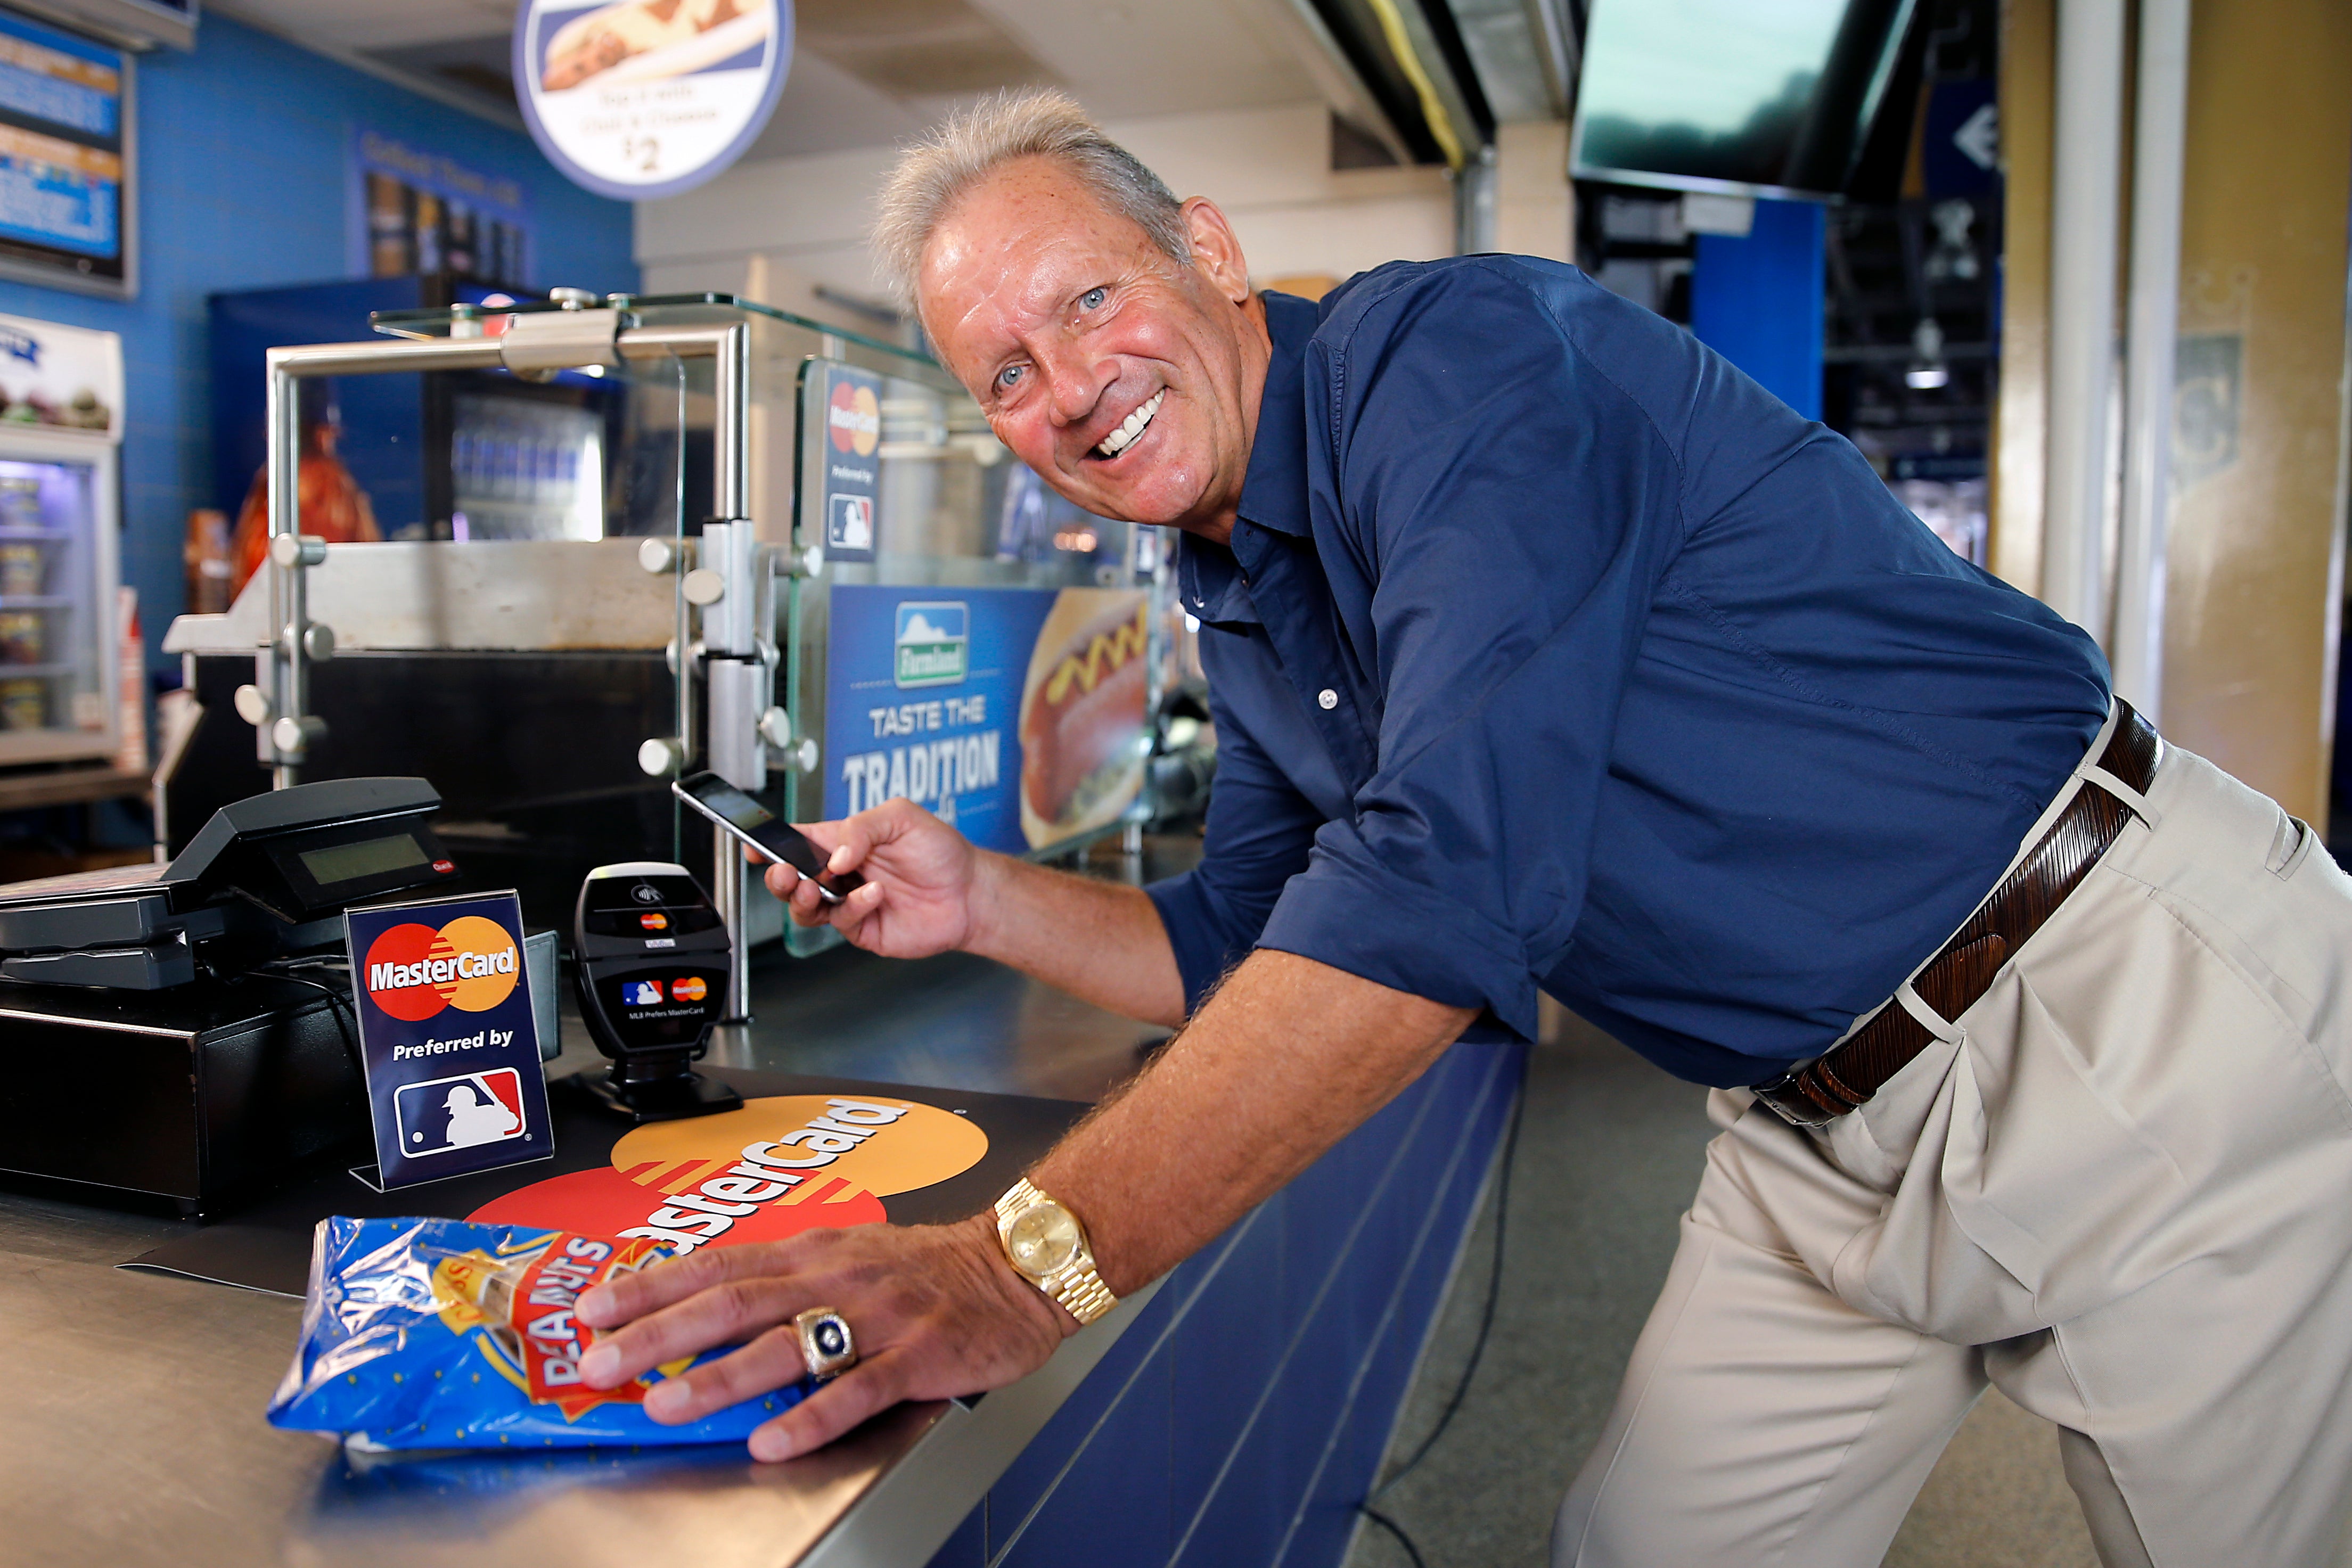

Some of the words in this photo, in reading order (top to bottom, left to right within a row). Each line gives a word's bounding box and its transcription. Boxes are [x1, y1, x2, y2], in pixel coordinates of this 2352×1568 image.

[868, 700, 942, 738] TASTE
[945, 694, 987, 726] THE
[841, 729, 1001, 818] TRADITION
[370, 946, 514, 992] MasterCard
[668, 1007, 704, 1016] MasterCard
[392, 1031, 485, 1061] Preferred
[489, 1029, 514, 1048] by
[615, 1098, 909, 1257] asterCard
